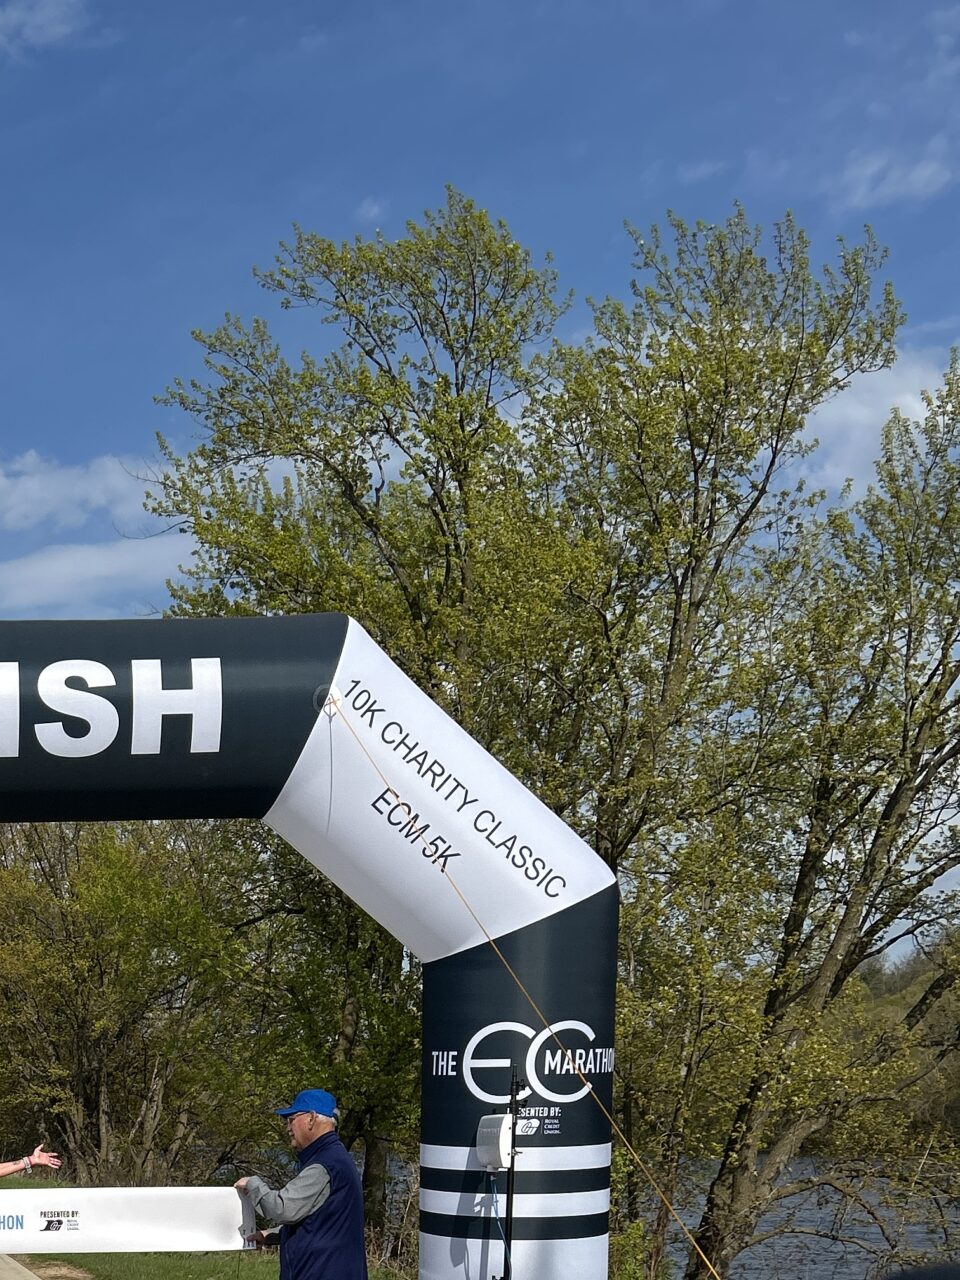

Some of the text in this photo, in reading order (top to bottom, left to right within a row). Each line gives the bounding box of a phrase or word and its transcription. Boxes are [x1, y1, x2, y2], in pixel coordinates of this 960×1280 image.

[343, 678, 568, 898] 10K CHARITY CLASSIC
[370, 786, 462, 873] ECM 5K
[431, 1051, 458, 1076] THE
[549, 1106, 562, 1117] BY:
[40, 1210, 70, 1219] PRESENTED
